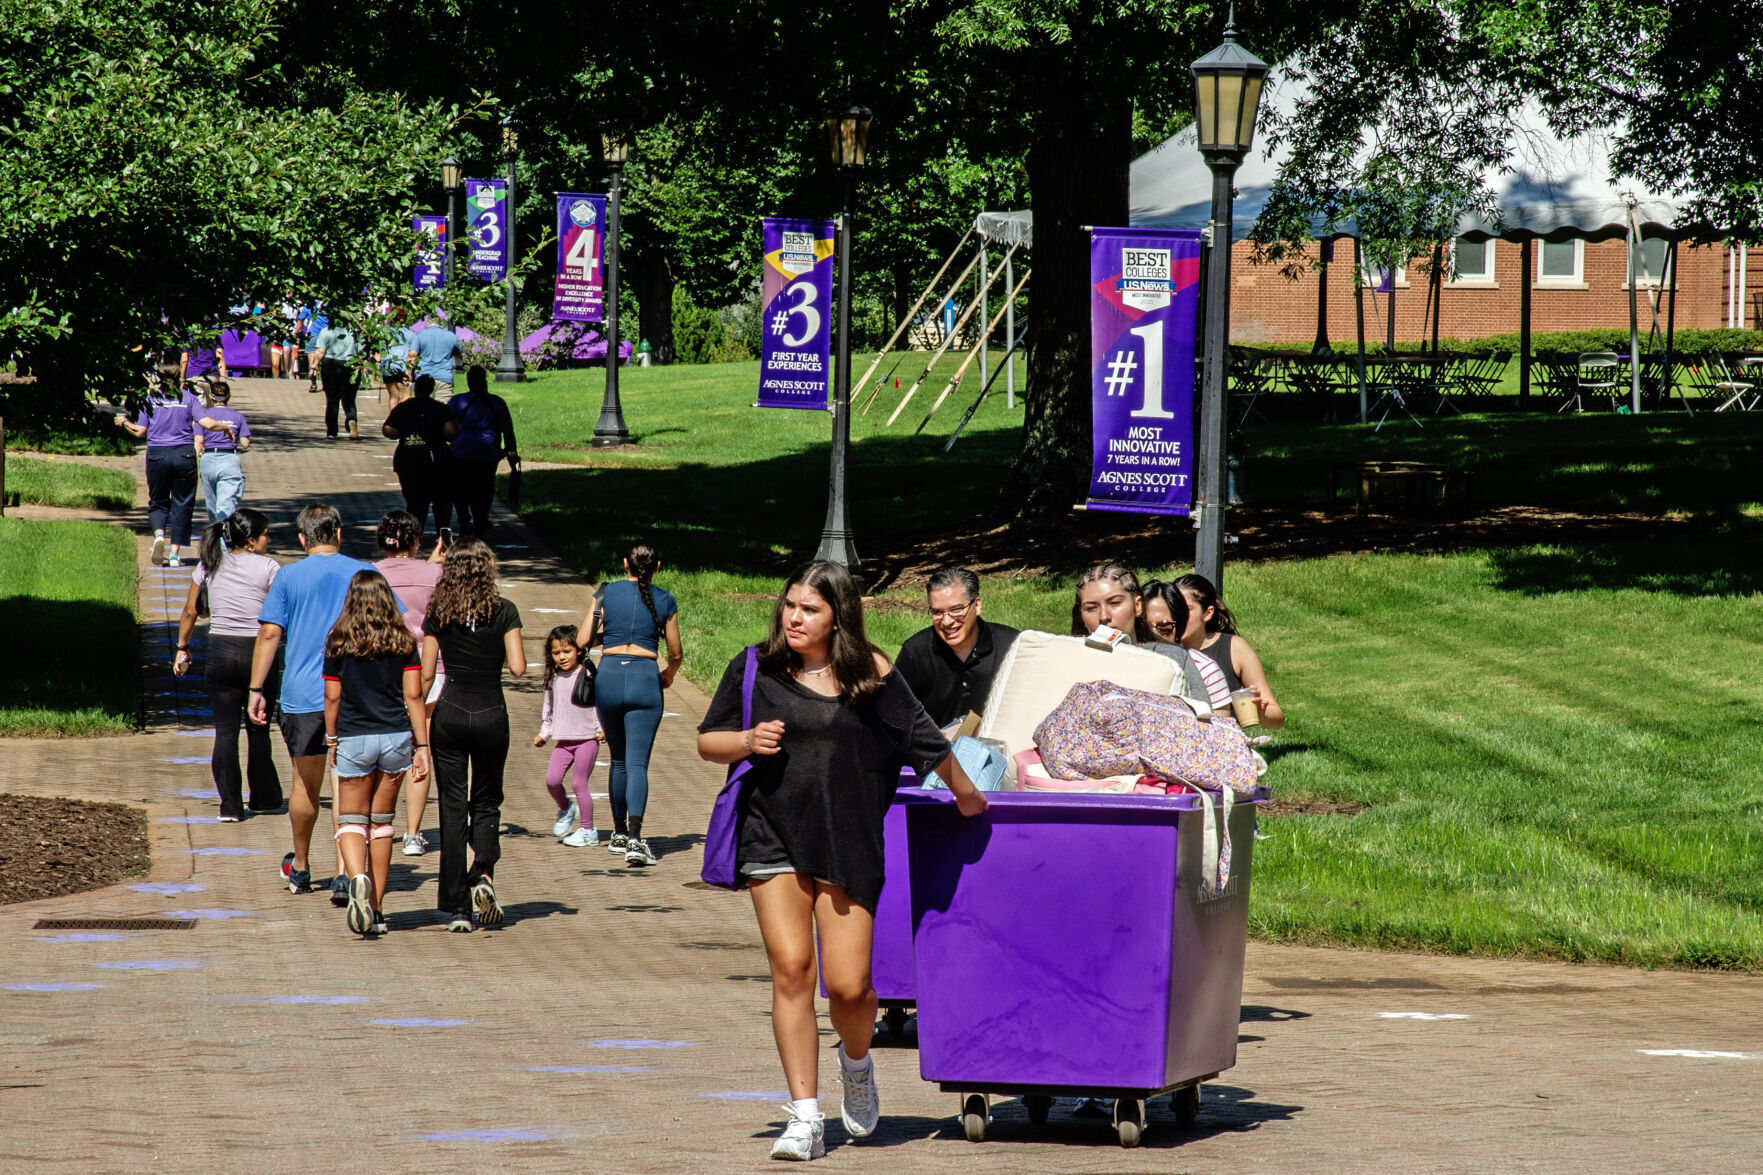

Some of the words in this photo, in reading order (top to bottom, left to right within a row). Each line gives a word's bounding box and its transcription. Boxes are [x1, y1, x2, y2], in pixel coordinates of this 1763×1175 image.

[784, 234, 812, 245] BEST
[566, 229, 598, 281] 4
[1126, 252, 1167, 267] BEST
[1126, 267, 1167, 278] COLLEGES
[771, 281, 821, 347] #3
[772, 352, 796, 361] FIRST
[797, 352, 819, 362] YEAR
[768, 360, 822, 371] EXPERIENCES
[1104, 320, 1174, 419] #1
[763, 379, 793, 389] AGNES
[794, 381, 825, 391] SCOTT
[1128, 426, 1163, 440] MOST
[1109, 439, 1181, 454] INNOVATIVE
[1107, 454, 1113, 463] 7
[1115, 455, 1139, 464] YEARS
[1141, 456, 1150, 465] IN
[1151, 457, 1157, 465] A
[1159, 457, 1180, 466] ROW!
[1097, 471, 1143, 485] AGNES
[1143, 473, 1187, 487] SCOTT
[1115, 485, 1166, 493] COLLEGE
